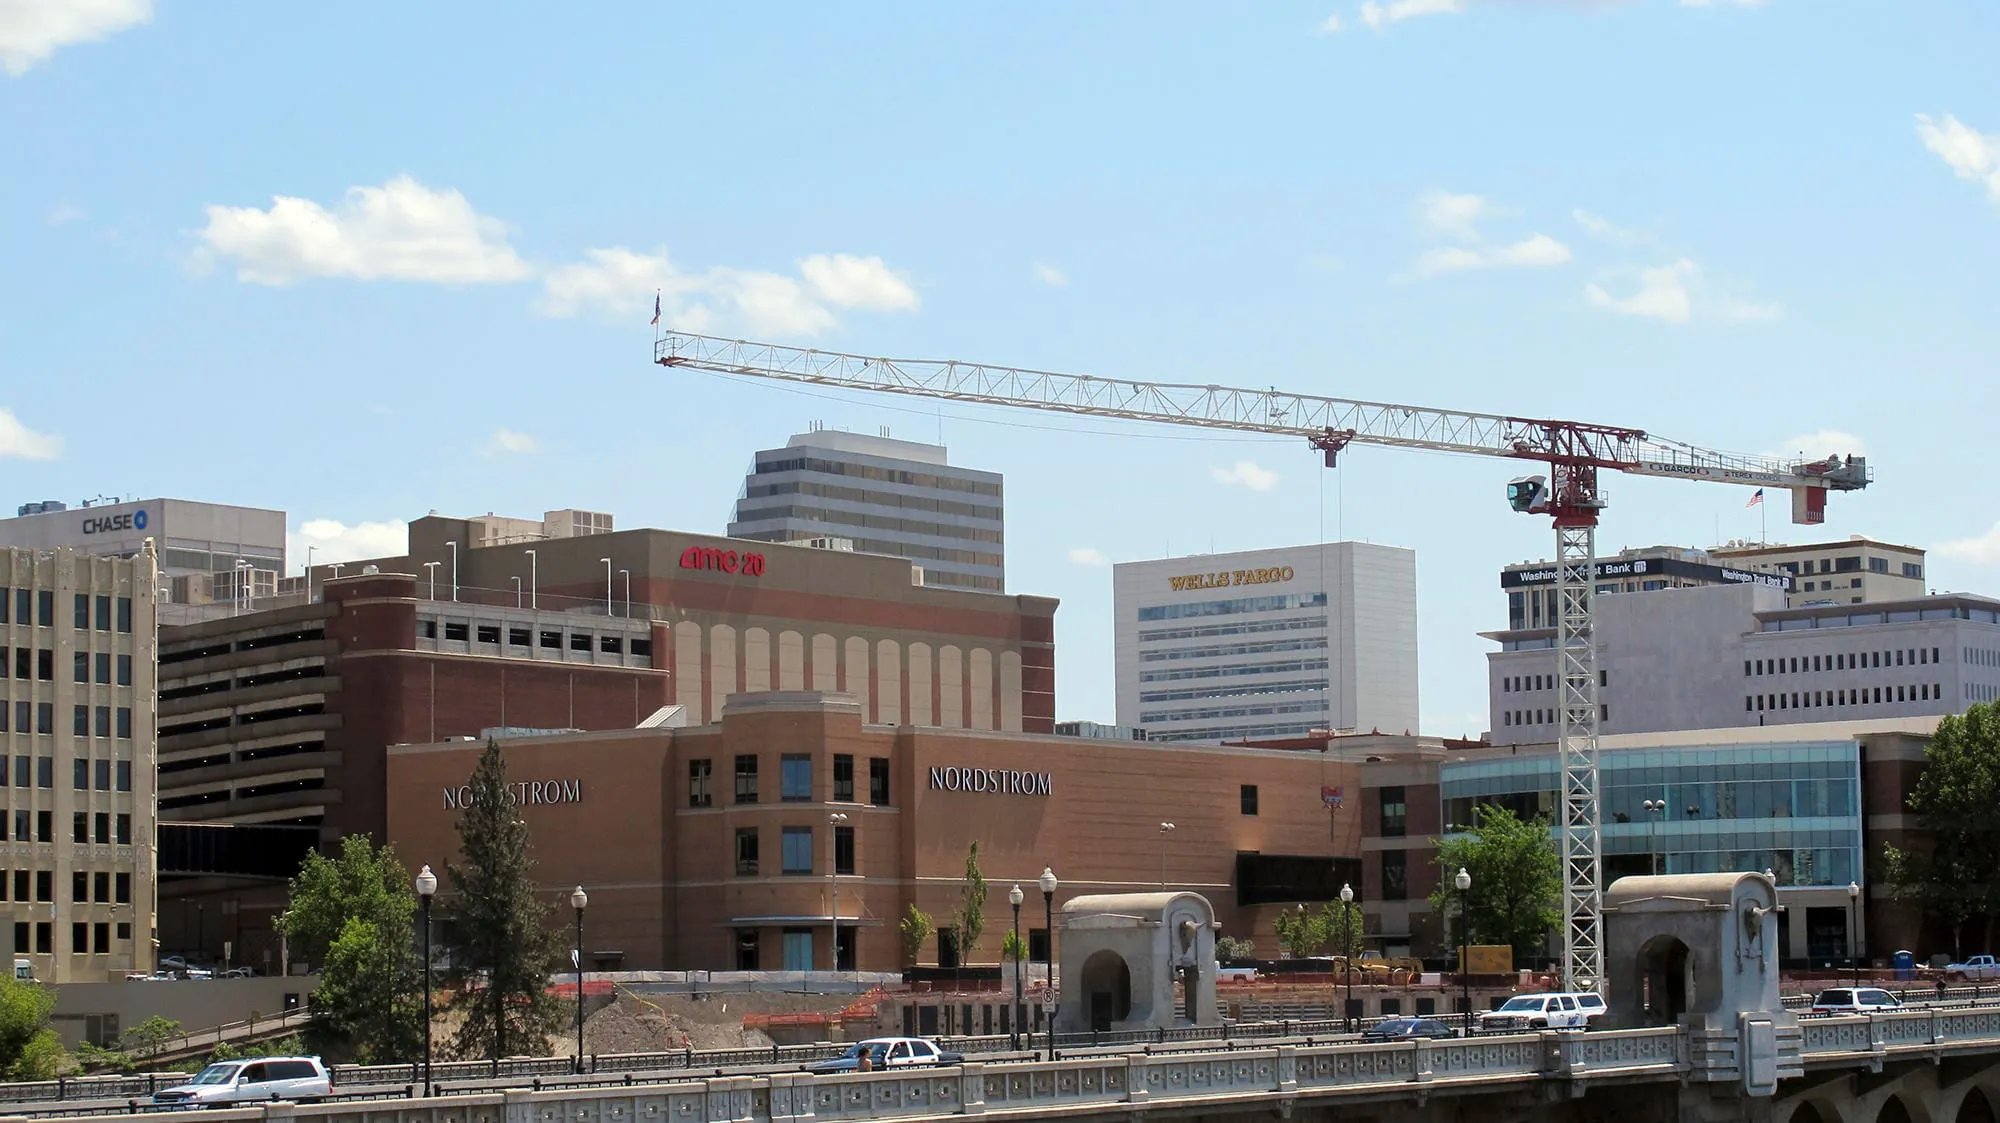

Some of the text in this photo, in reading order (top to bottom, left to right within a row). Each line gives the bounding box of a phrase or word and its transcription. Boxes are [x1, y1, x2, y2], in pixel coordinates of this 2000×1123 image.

[1664, 465, 1696, 474] GARCO
[1731, 471, 1752, 480] TEREX
[83, 513, 133, 534] CHASE
[742, 552, 766, 576] 20
[1520, 563, 1631, 583] Washingon Trst Bank
[1168, 566, 1294, 592] WELLS FARGO
[1721, 568, 1781, 588] Washington Trust Bank
[930, 766, 1052, 796] NORDSTROM
[443, 779, 582, 810] NOSTROM
